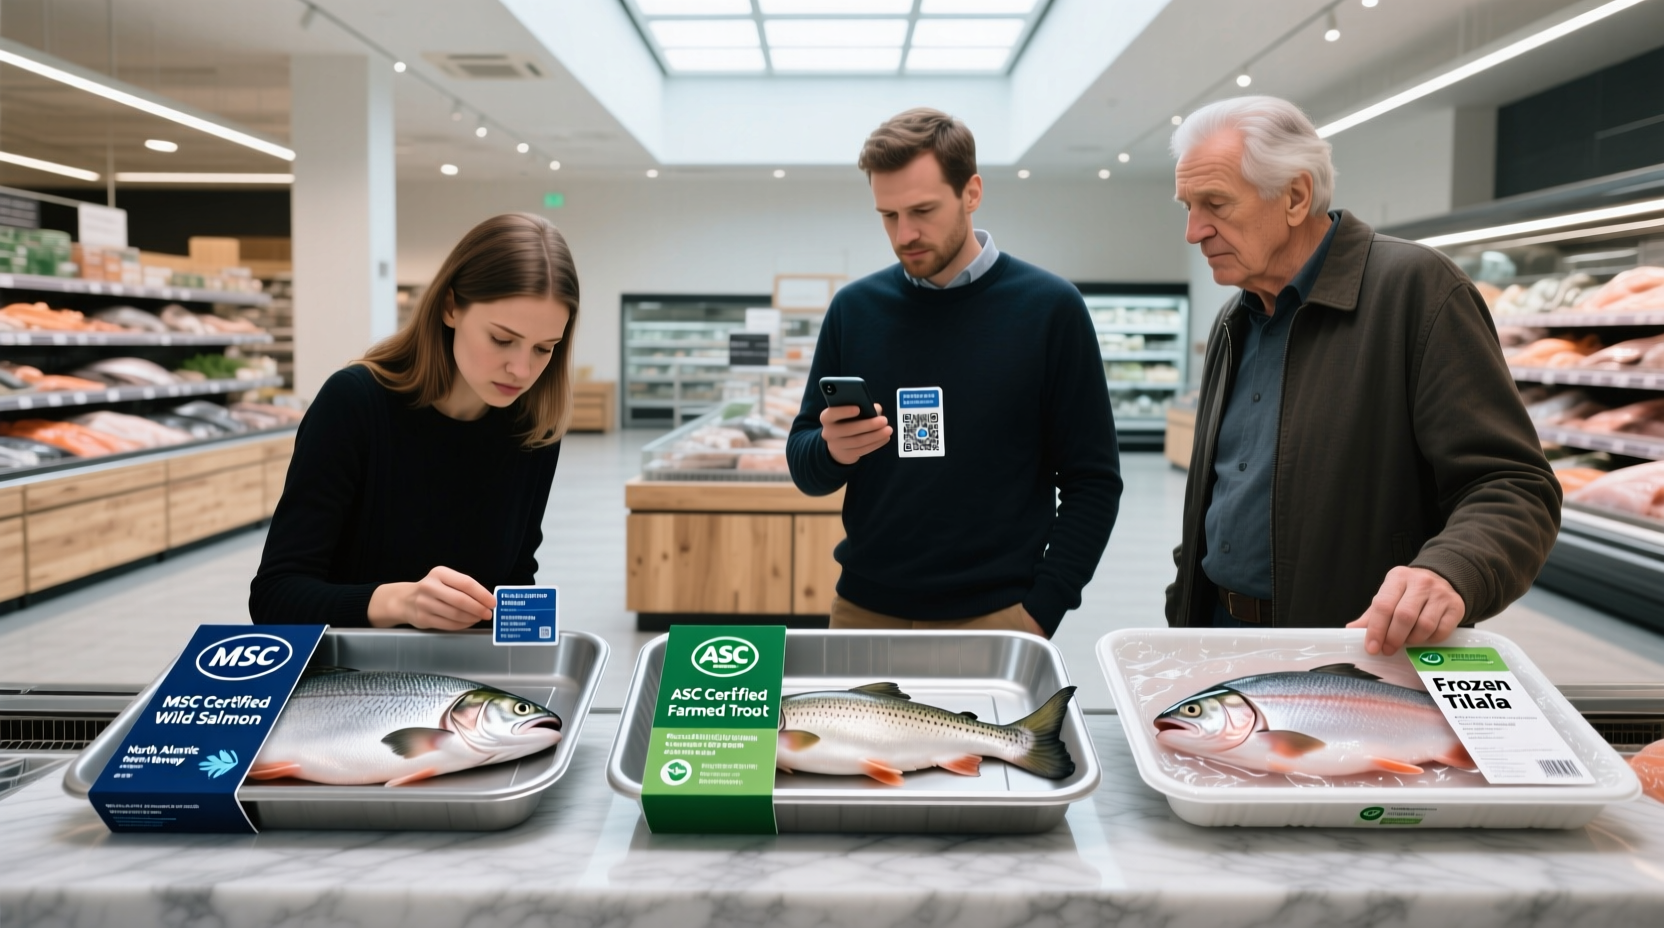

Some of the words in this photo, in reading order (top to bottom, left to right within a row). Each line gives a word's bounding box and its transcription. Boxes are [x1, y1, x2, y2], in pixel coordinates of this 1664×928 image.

[208, 646, 281, 667] MSC
[699, 645, 749, 665] ASC
[1432, 677, 1512, 692] Frozen
[671, 687, 702, 701] ASC
[162, 695, 203, 709] MSC
[155, 710, 196, 725] Wild
[196, 710, 262, 725] Salmon
[667, 704, 726, 717] Farmed
